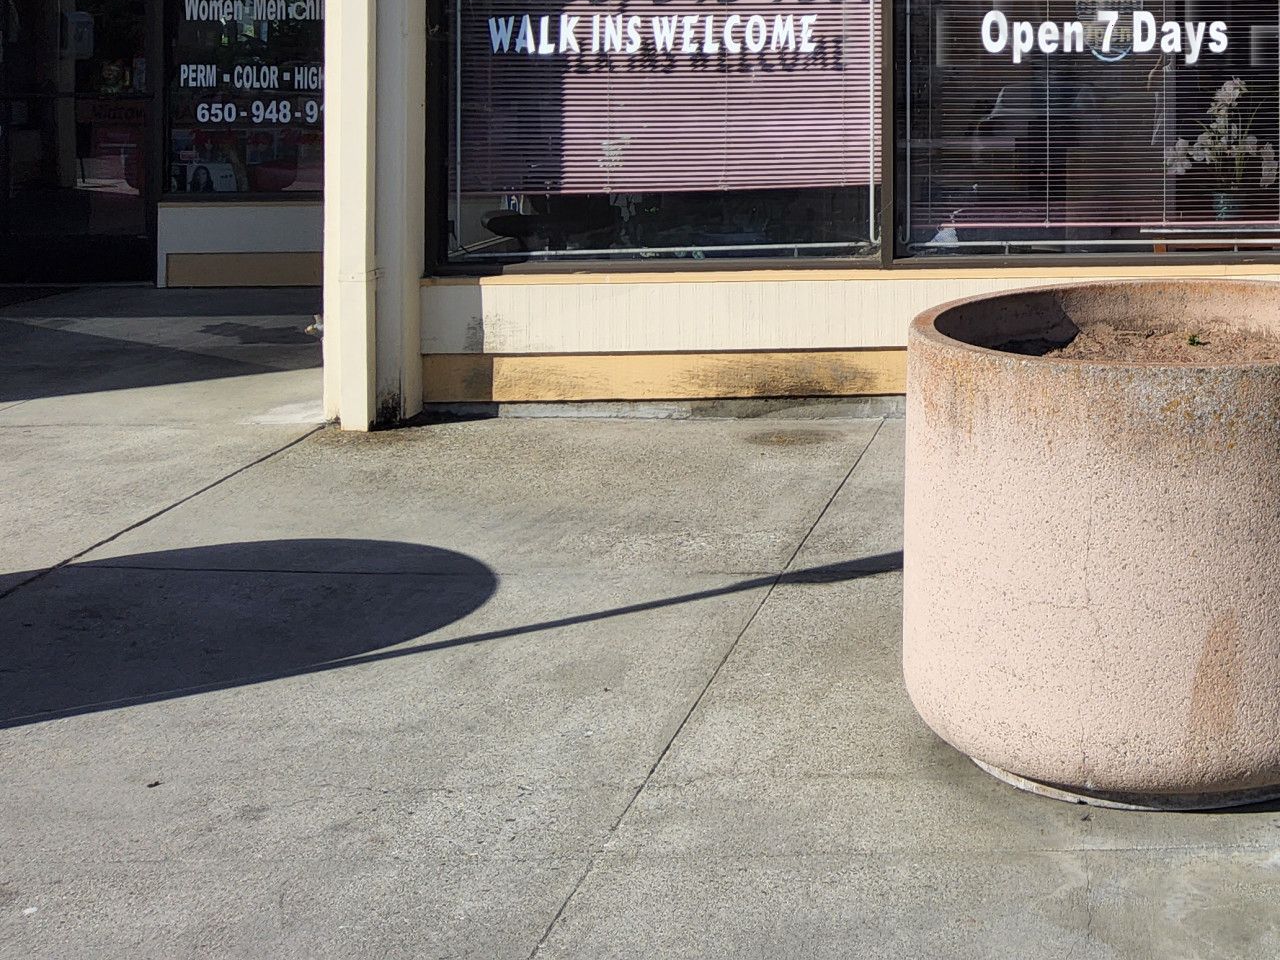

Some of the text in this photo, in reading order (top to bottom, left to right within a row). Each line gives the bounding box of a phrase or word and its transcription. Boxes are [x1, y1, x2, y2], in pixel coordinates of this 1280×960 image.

[488, 14, 819, 55] WALK INS WELCOME
[980, 9, 1085, 64] Open
[1096, 10, 1120, 54] 7
[1132, 10, 1229, 65] Days
[180, 64, 217, 87] PERM
[233, 65, 279, 89] COLOR
